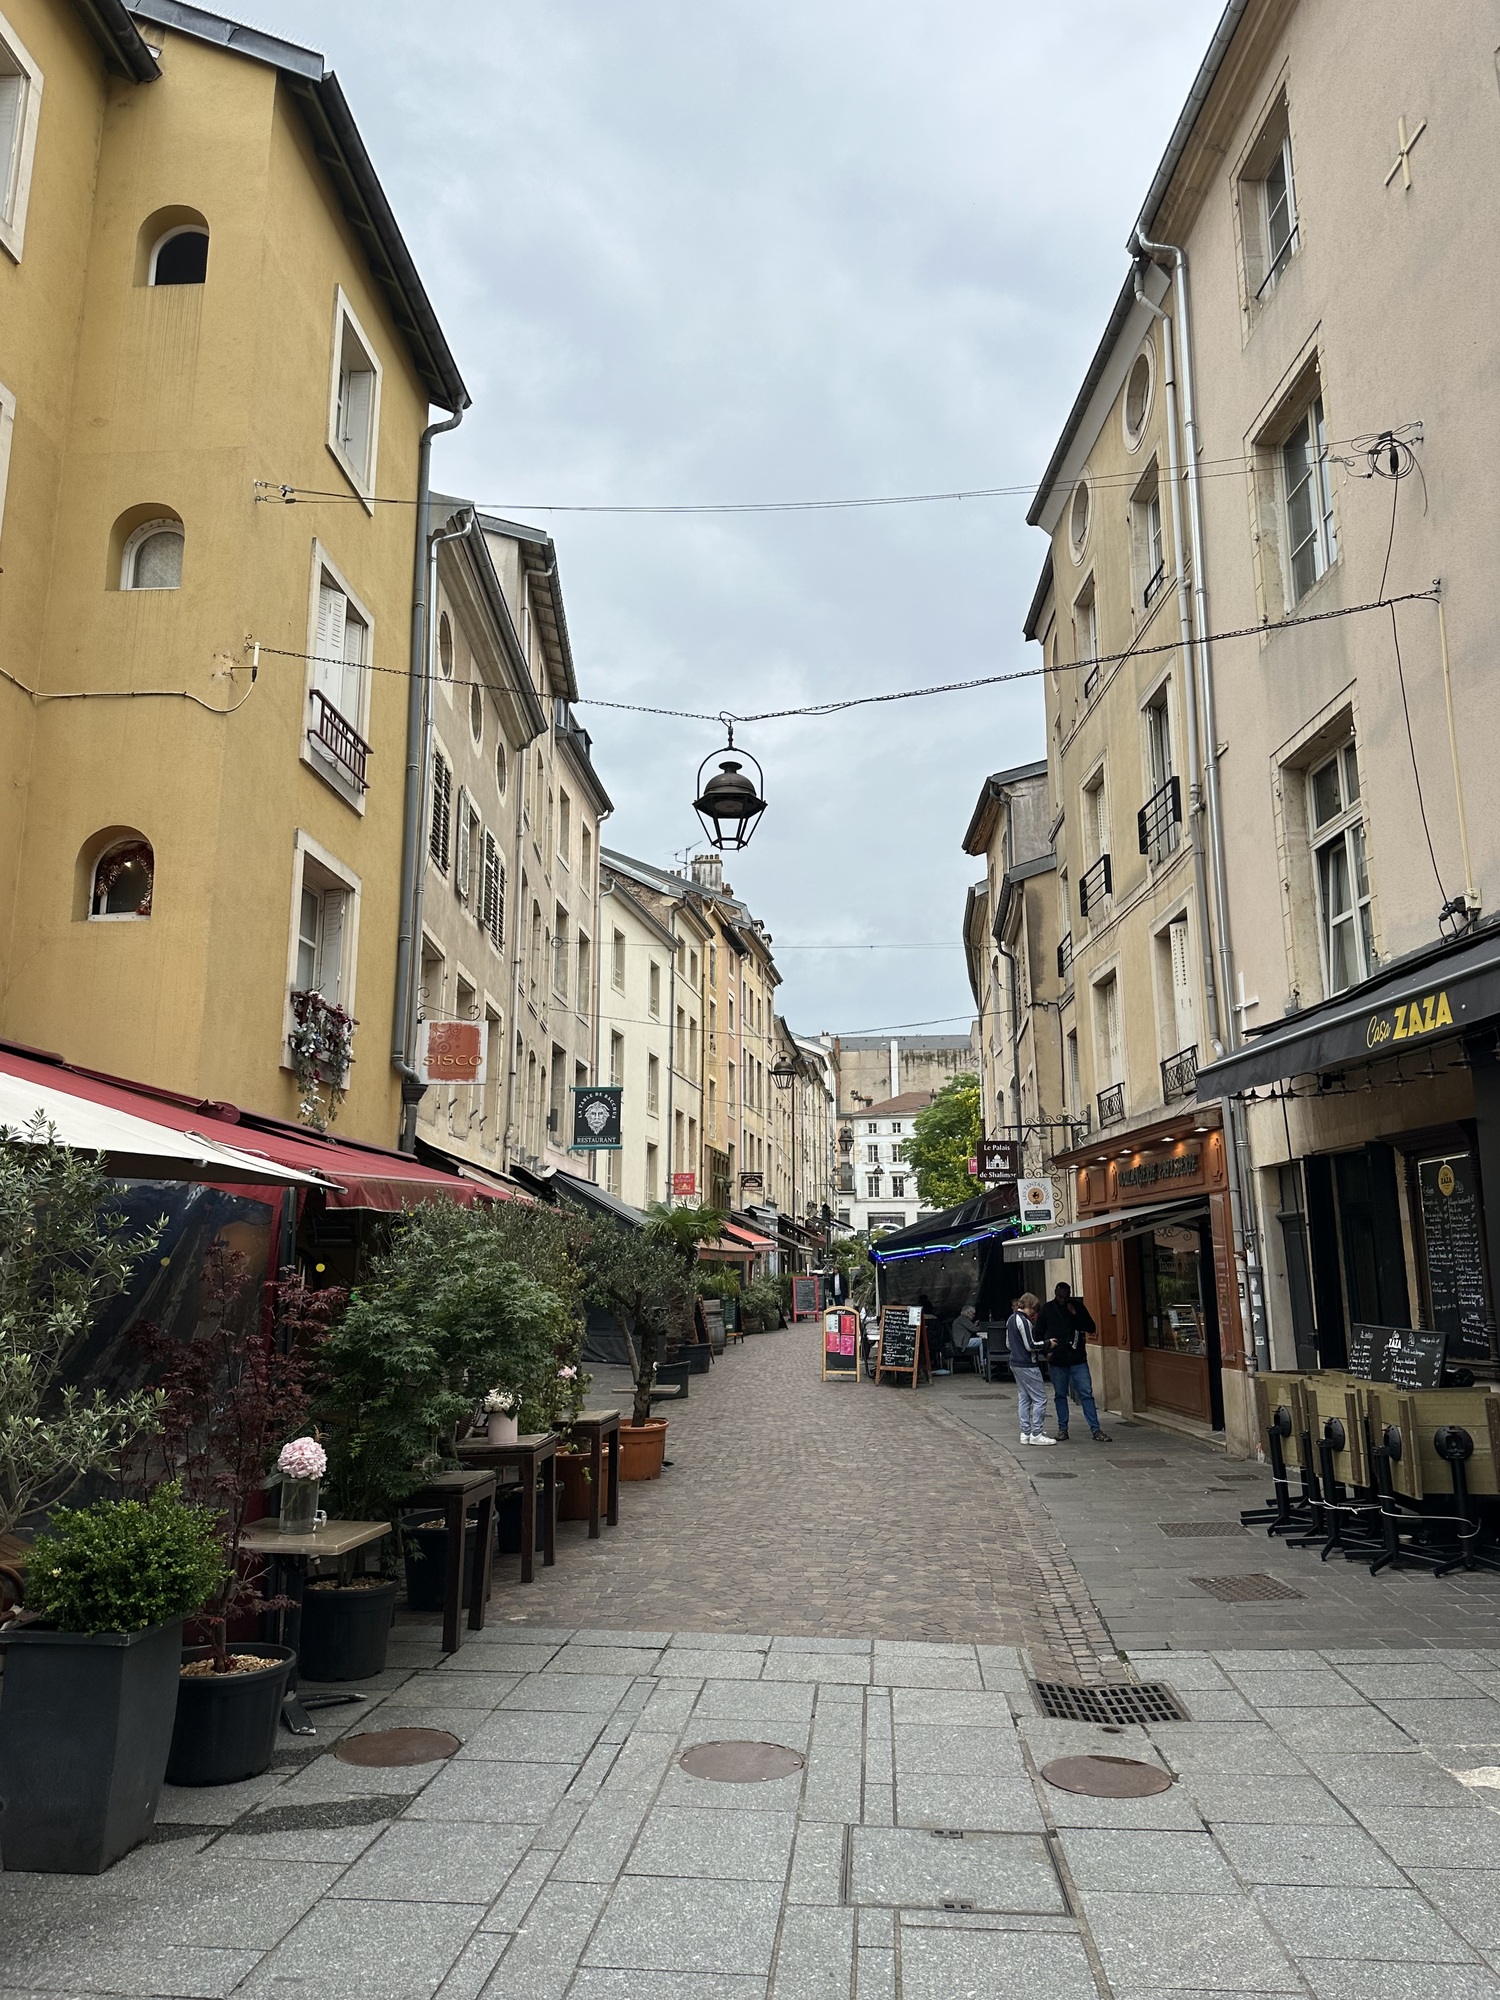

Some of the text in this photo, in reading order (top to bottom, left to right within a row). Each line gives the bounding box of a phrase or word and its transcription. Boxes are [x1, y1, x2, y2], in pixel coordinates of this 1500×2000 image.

[1366, 991, 1453, 1048] Casa ZAZA
[422, 1054, 483, 1066] SISCO
[578, 1093, 593, 1109] TABLE
[603, 1094, 617, 1119] BACCHUS
[1440, 1176, 1453, 1185] ZAZA
[1388, 1338, 1402, 1349] ZAZA
